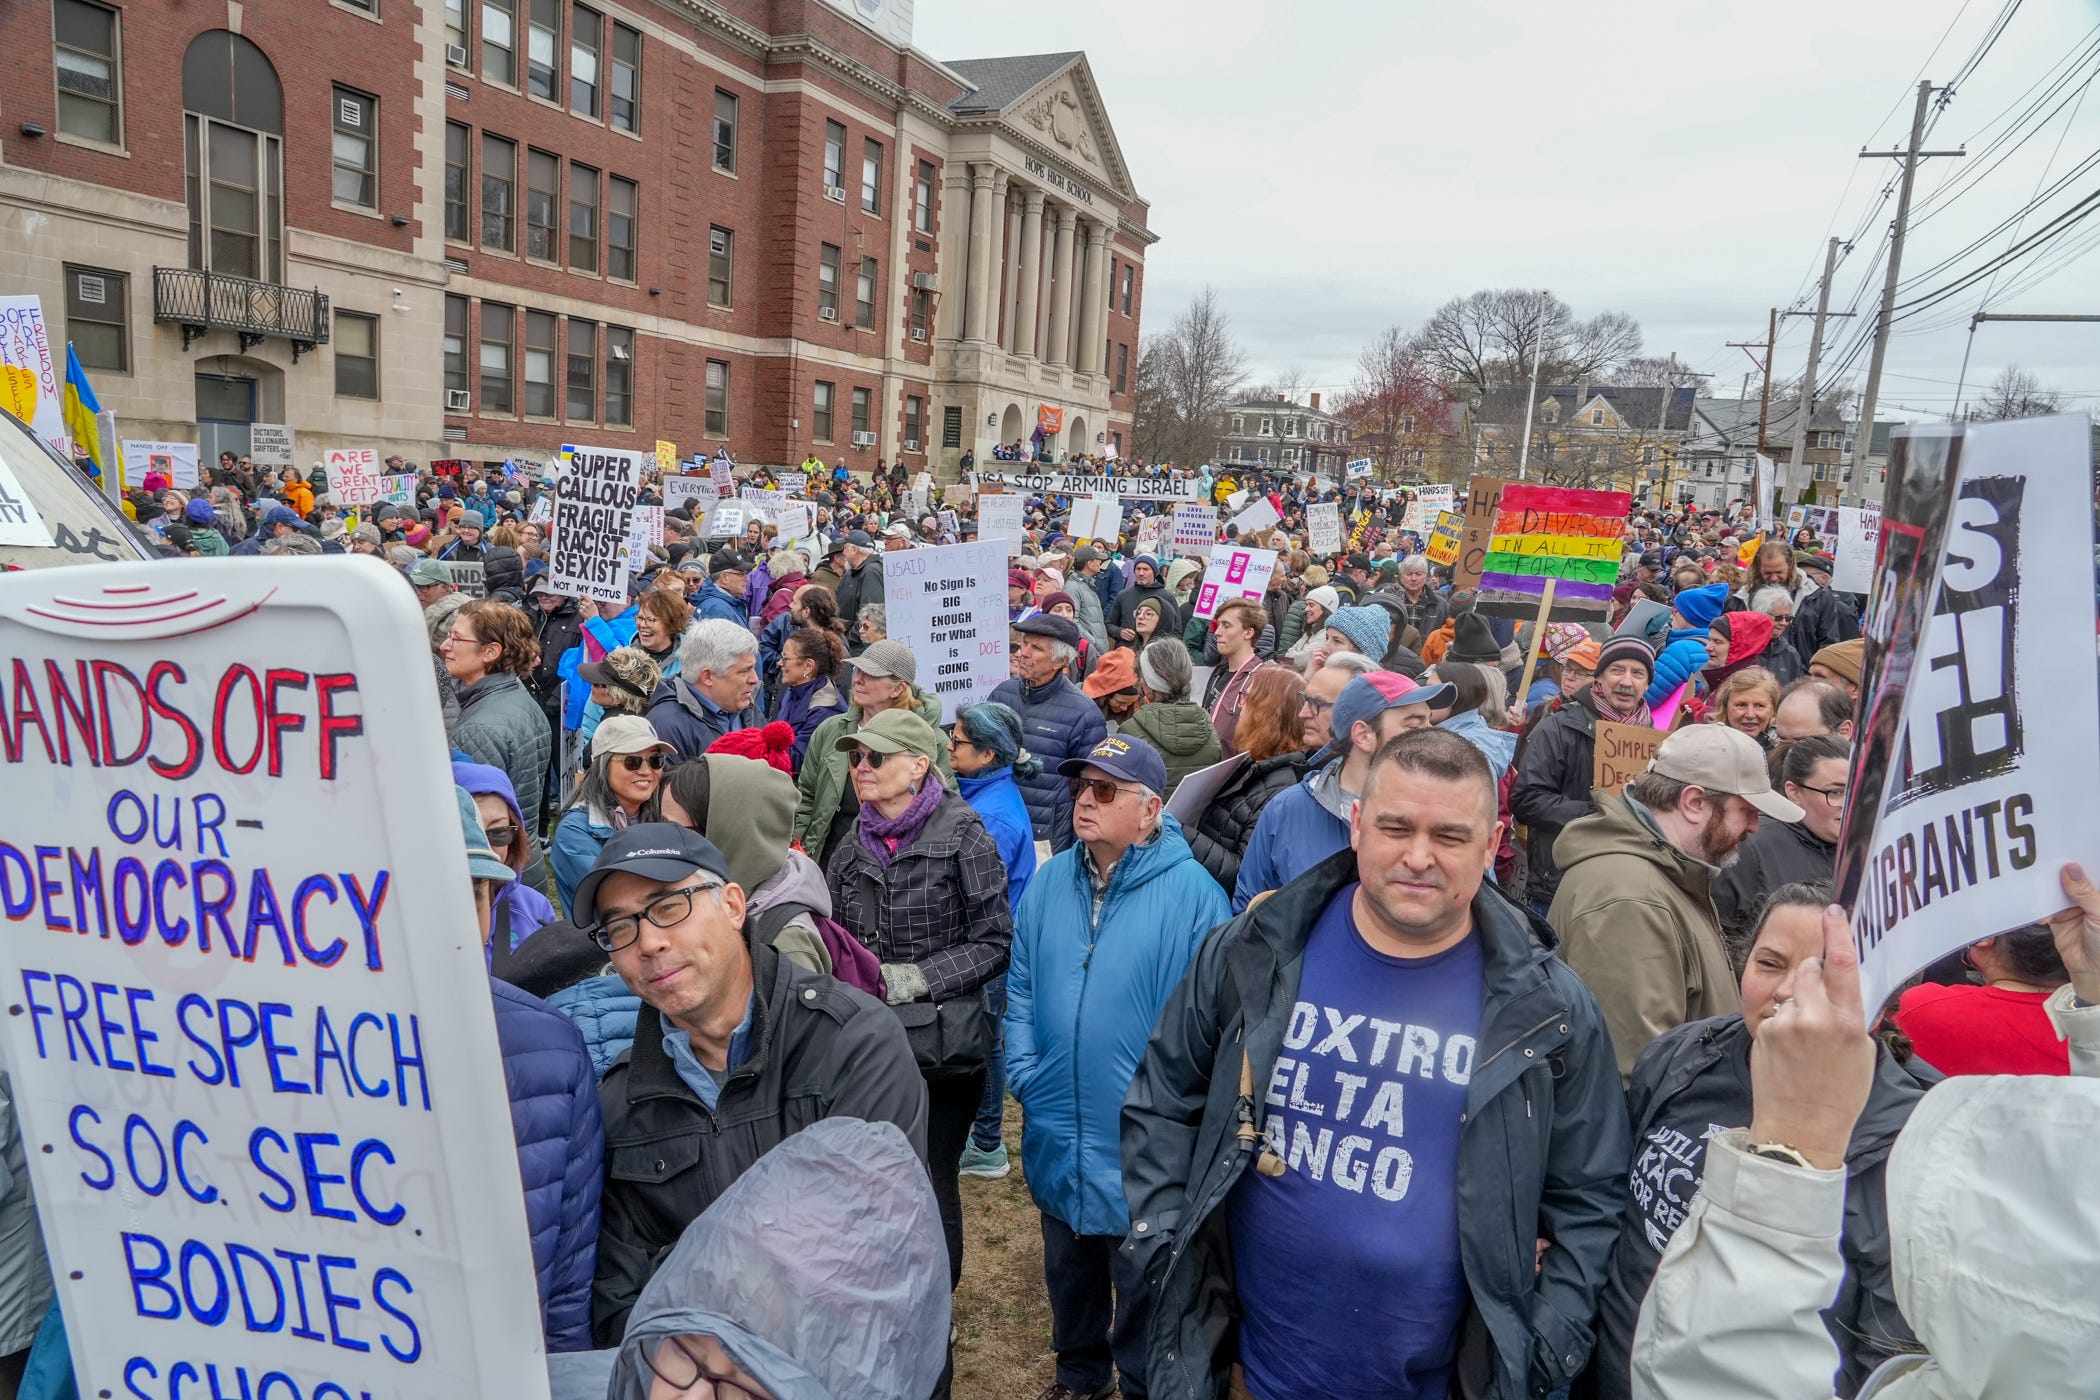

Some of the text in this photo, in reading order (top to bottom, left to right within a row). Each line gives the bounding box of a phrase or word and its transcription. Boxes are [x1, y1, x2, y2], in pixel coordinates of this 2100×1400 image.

[1025, 156, 1094, 206] HOPE HIGH SCHOOL
[331, 450, 374, 464] ARE
[1347, 460, 1369, 469] HANDS
[339, 464, 362, 475] WE
[570, 452, 632, 483] SUPER
[330, 474, 379, 490] GREAT
[381, 474, 415, 495] EQUALITY
[1014, 474, 1053, 490] STOP
[1061, 476, 1127, 494] ARMING
[1136, 478, 1190, 496] ISRAEL
[339, 487, 379, 504] YET?
[557, 475, 637, 511] CALLOUS
[744, 489, 770, 500] HANDS
[1418, 486, 1440, 496] HANDS
[557, 503, 633, 538] FRAGILE
[1177, 512, 1214, 520] DEMOCRACY
[1176, 528, 1213, 536] TOGETHER
[557, 527, 624, 560] RACIST
[1174, 537, 1214, 546] RESIST!!!
[1499, 538, 1523, 553] IN
[1533, 539, 1570, 556] ALL
[554, 551, 622, 586] SEXIST
[885, 557, 927, 578] USAID
[1215, 558, 1231, 566] USAID
[1254, 565, 1272, 573] USAID
[1514, 555, 1599, 583] FORMS
[553, 580, 622, 600] NOT MY POTUS
[924, 576, 976, 593] No Sign Is
[942, 595, 961, 609] BIG
[931, 611, 972, 627] ENOUGH
[930, 628, 977, 643] For What
[948, 647, 959, 658] is
[979, 640, 1001, 656] DOE
[937, 661, 970, 676] GOING
[934, 677, 973, 694] WRONG
[211, 662, 364, 781] OFF
[636, 847, 681, 858] Columbia
[0, 841, 391, 973] DEMOCRACY
[20, 968, 433, 1112] FREE SPEACH
[1648, 1125, 1703, 1168] WILL
[68, 1104, 424, 1237] SOC. SEC.
[1629, 1168, 1654, 1211] FOR
[120, 1230, 423, 1364] BODIES
